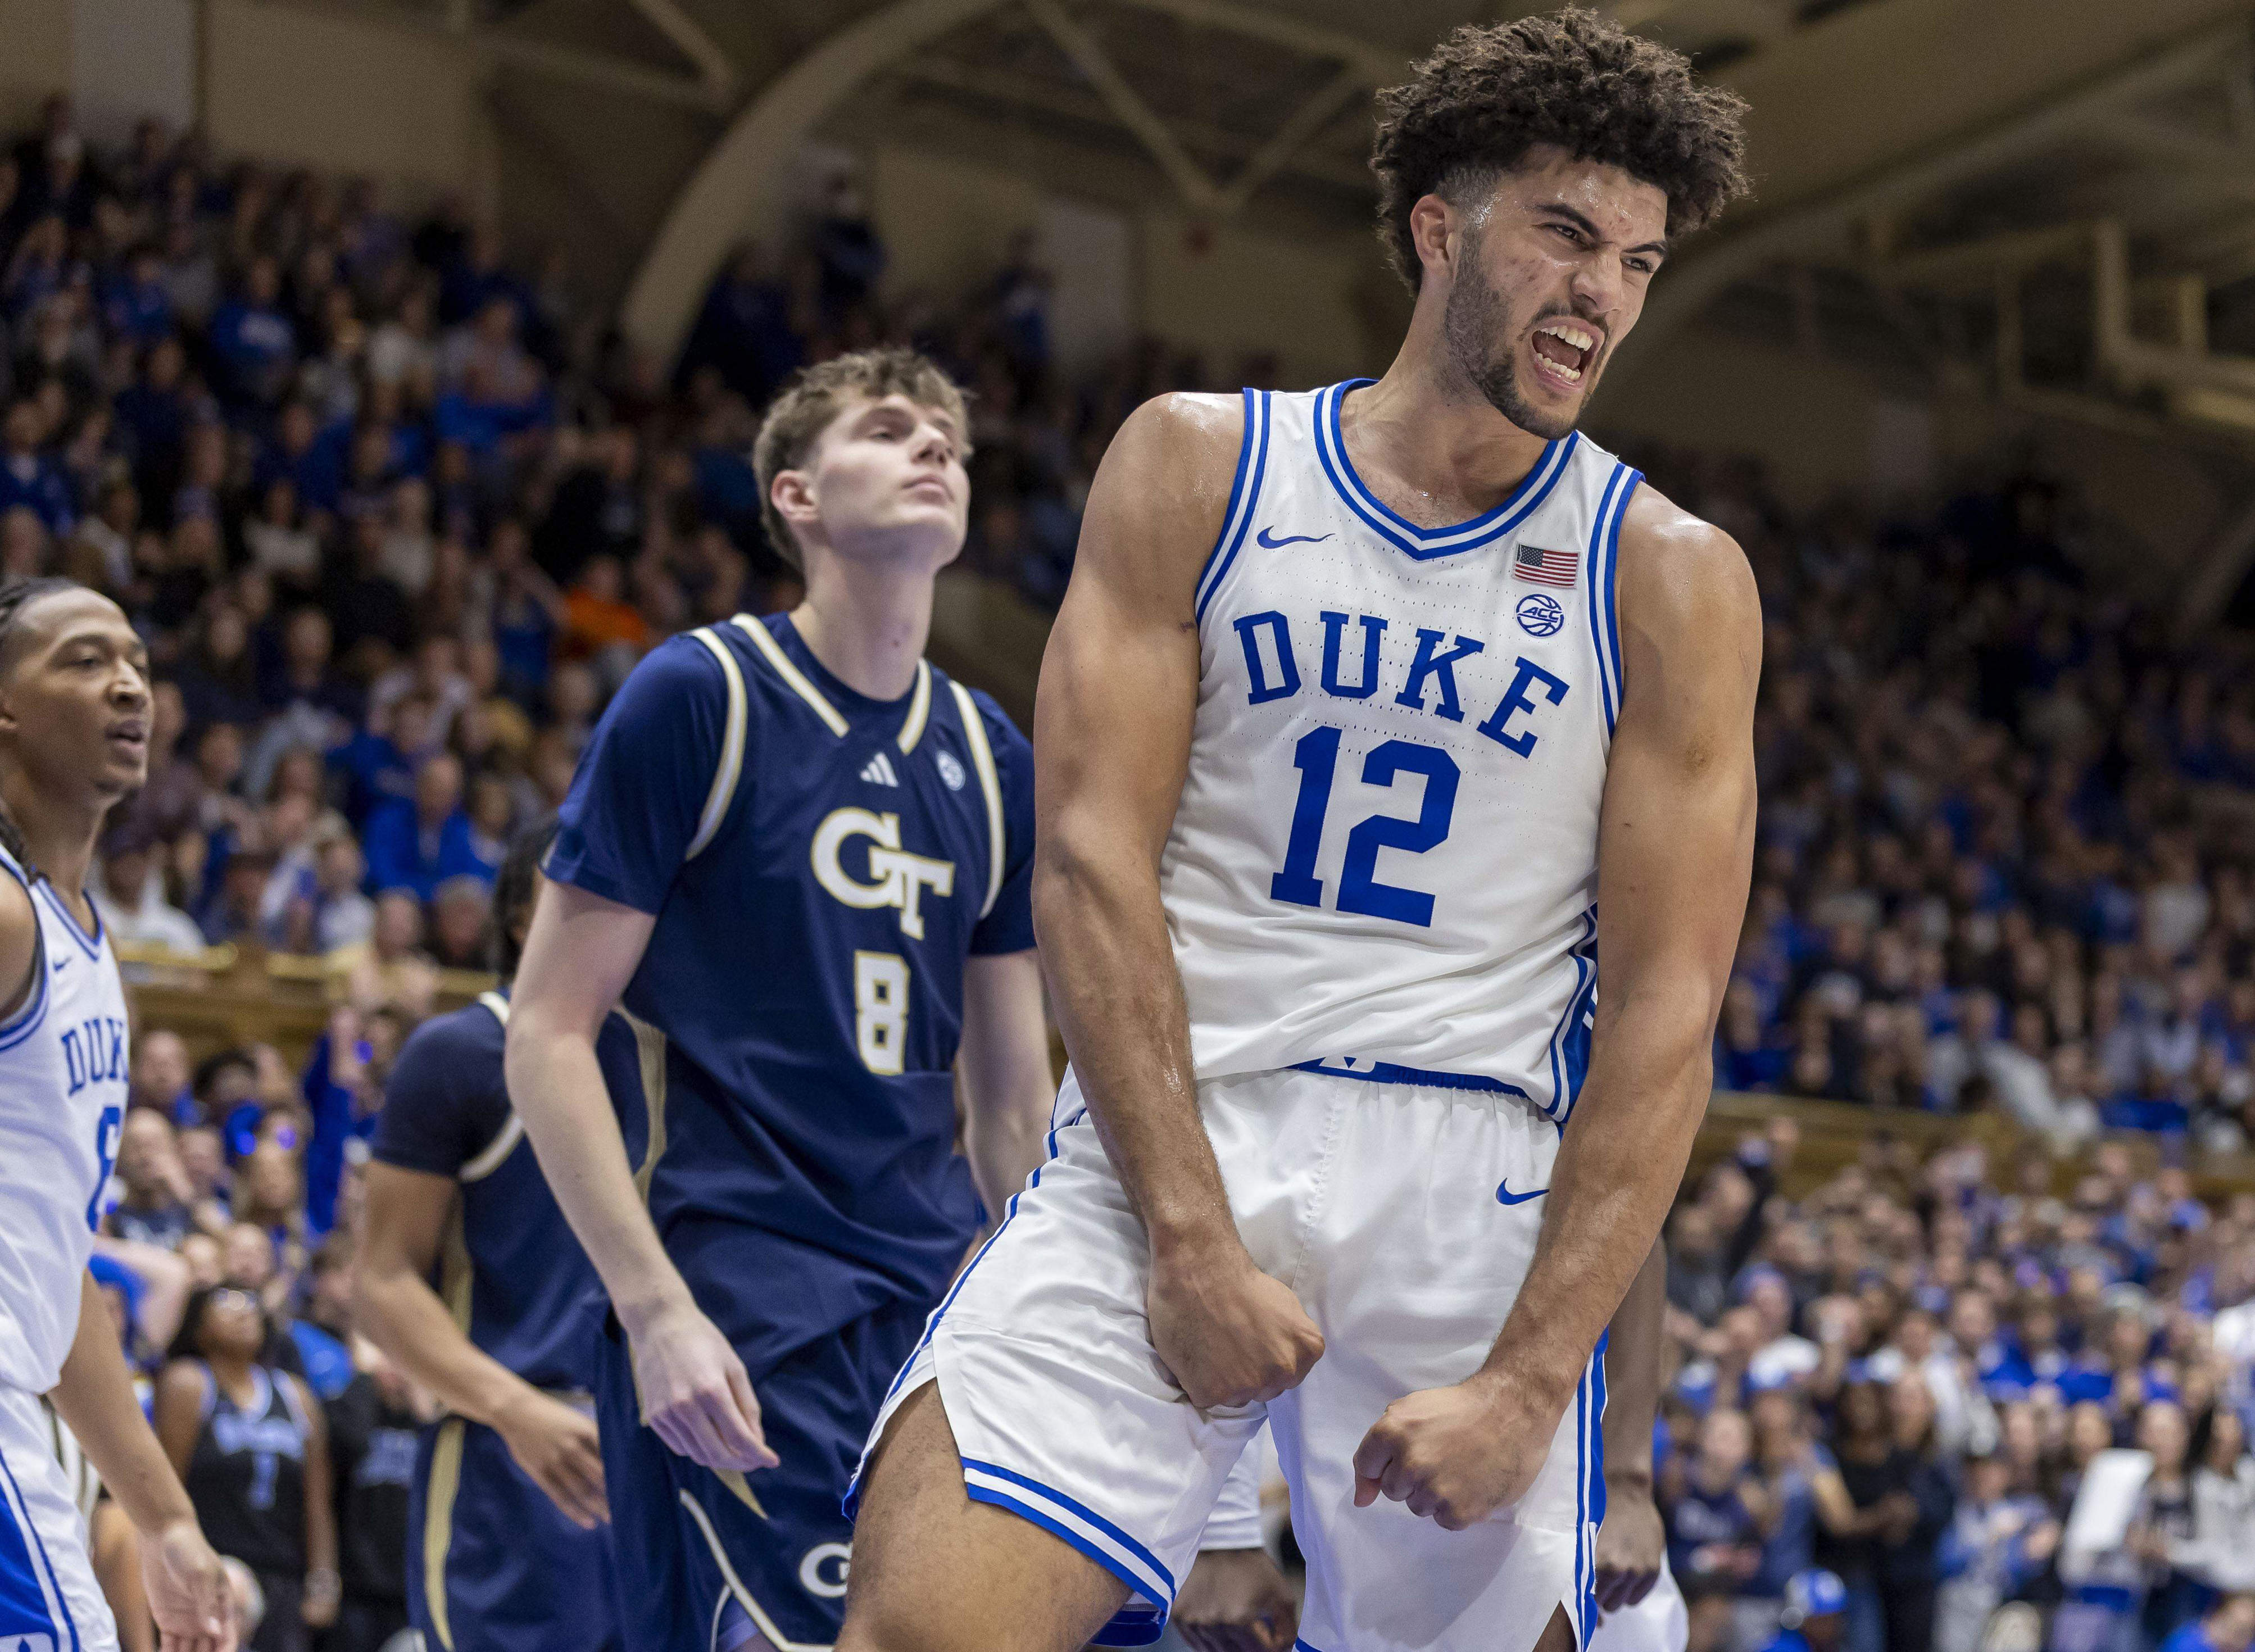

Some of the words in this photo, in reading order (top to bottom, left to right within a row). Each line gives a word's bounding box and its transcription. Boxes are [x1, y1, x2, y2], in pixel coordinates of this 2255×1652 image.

[1522, 607, 1563, 620] ACC
[1233, 610, 1570, 759] DUKE
[810, 806, 955, 941] GT
[1271, 725, 1461, 928] 12
[61, 1018, 129, 1098] DUK
[854, 948, 911, 1075] 8
[798, 1542, 853, 1597] G
